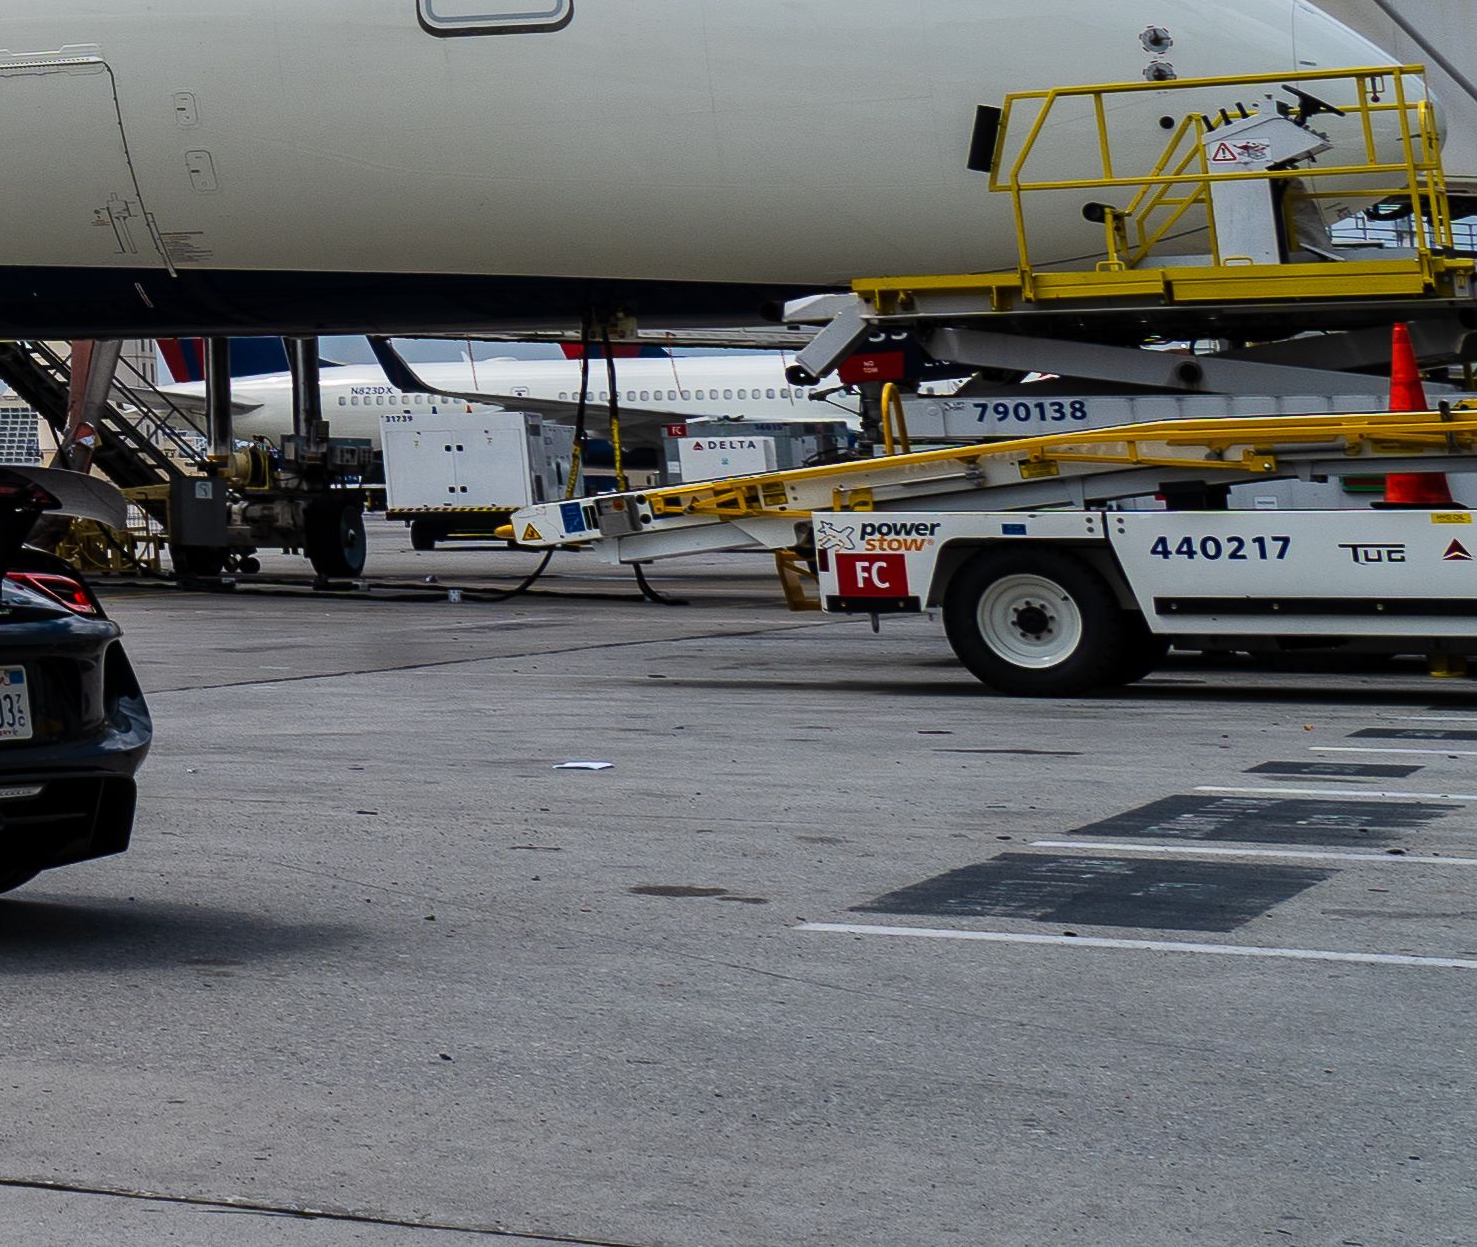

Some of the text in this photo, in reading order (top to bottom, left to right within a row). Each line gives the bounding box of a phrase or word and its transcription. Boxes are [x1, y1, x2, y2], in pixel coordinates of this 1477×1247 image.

[973, 400, 1087, 422] 790138
[707, 440, 756, 450] DELTA
[860, 522, 941, 541] power
[1149, 536, 1291, 560] 440217
[1338, 543, 1406, 565] TUG
[855, 561, 890, 588] FC
